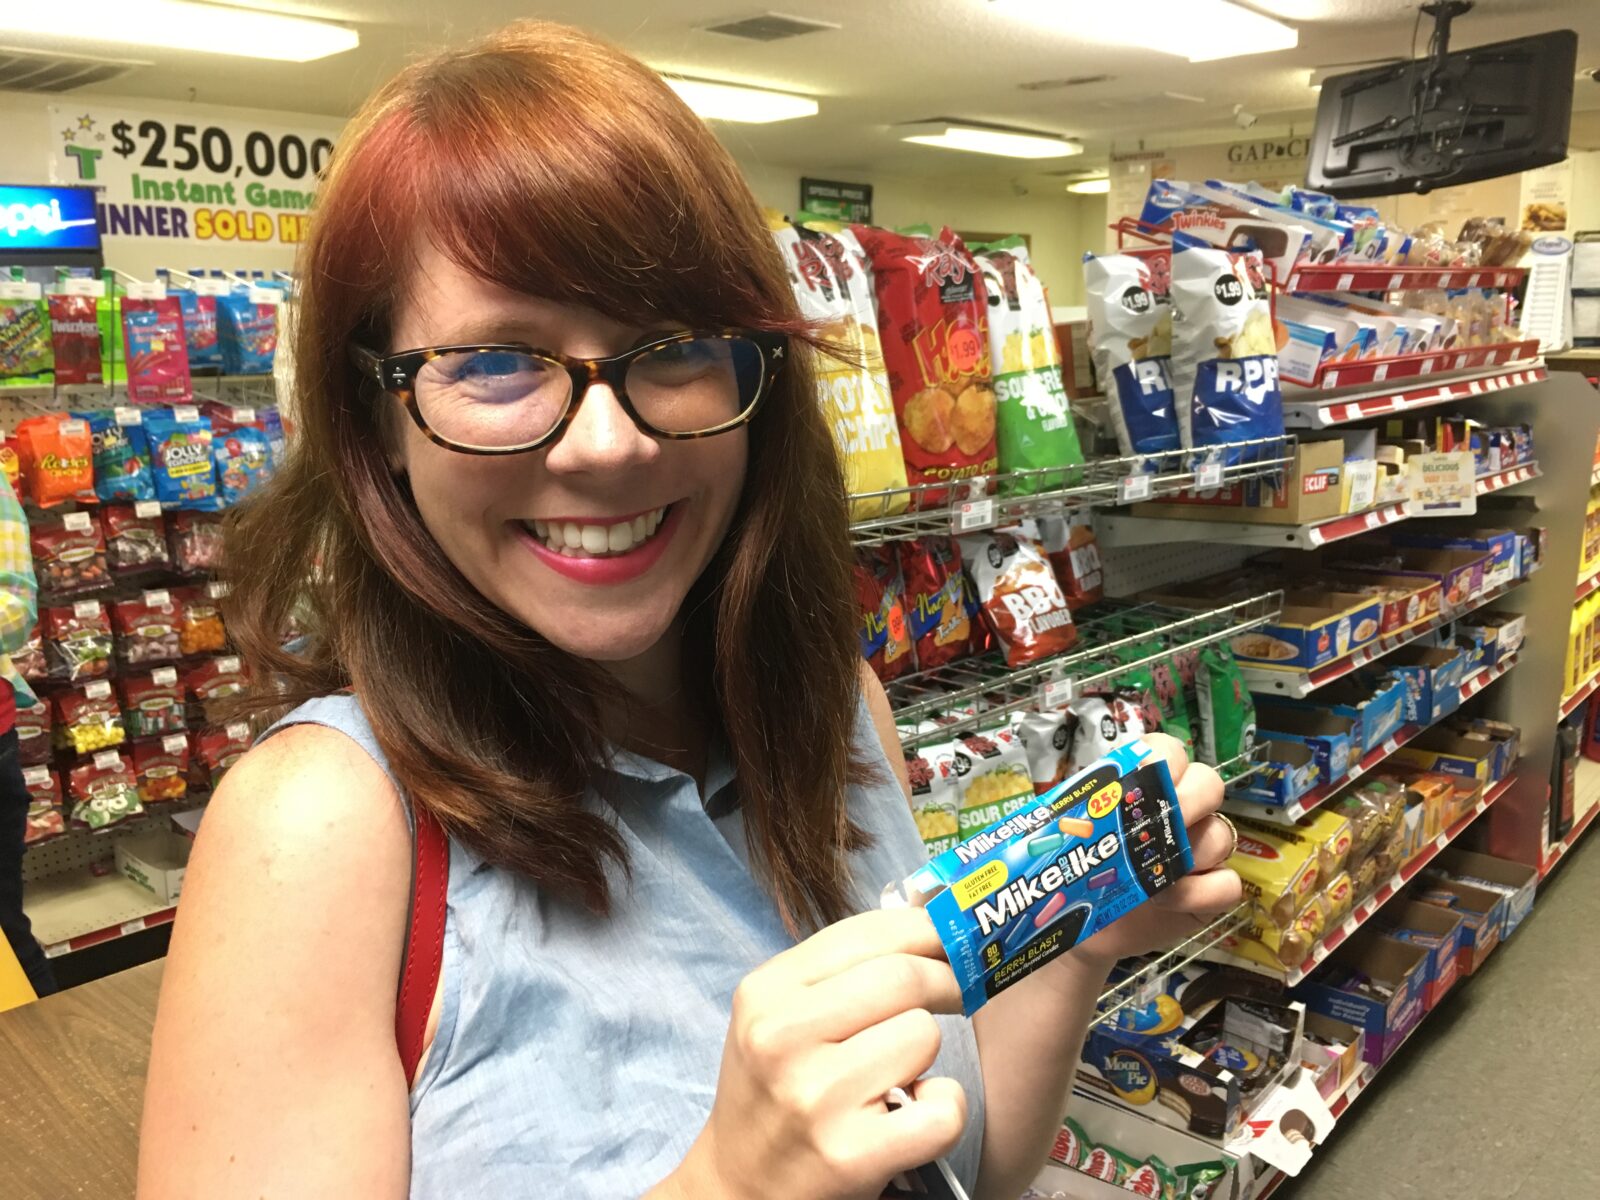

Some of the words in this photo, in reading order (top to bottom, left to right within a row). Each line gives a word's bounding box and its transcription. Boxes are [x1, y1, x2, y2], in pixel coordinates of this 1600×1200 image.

[112, 120, 334, 181] $250,000
[1228, 142, 1279, 162] GAP
[131, 173, 236, 206] Instant
[98, 203, 189, 239] INNER
[194, 208, 275, 242] SOLD
[1171, 210, 1228, 231] Twinkies
[1215, 282, 1242, 299] $1.99
[165, 443, 203, 461] JOLLY
[1422, 462, 1460, 473] DELICIOUS
[1308, 475, 1328, 491] CLIF
[1090, 789, 1119, 815] 25¢
[960, 804, 1002, 830] SOUR
[954, 824, 1012, 864] Mike
[964, 874, 985, 890] GLUTEN
[984, 864, 998, 877] FREE
[974, 864, 1064, 936] Mike
[1057, 855, 1078, 885] and
[1068, 832, 1121, 877] Ike
[968, 888, 979, 900] FAT
[978, 881, 992, 894] FREE
[986, 943, 998, 957] 80
[994, 953, 1026, 982] BERRY
[1103, 1056, 1140, 1071] Moon
[1127, 1071, 1148, 1085] Pie
